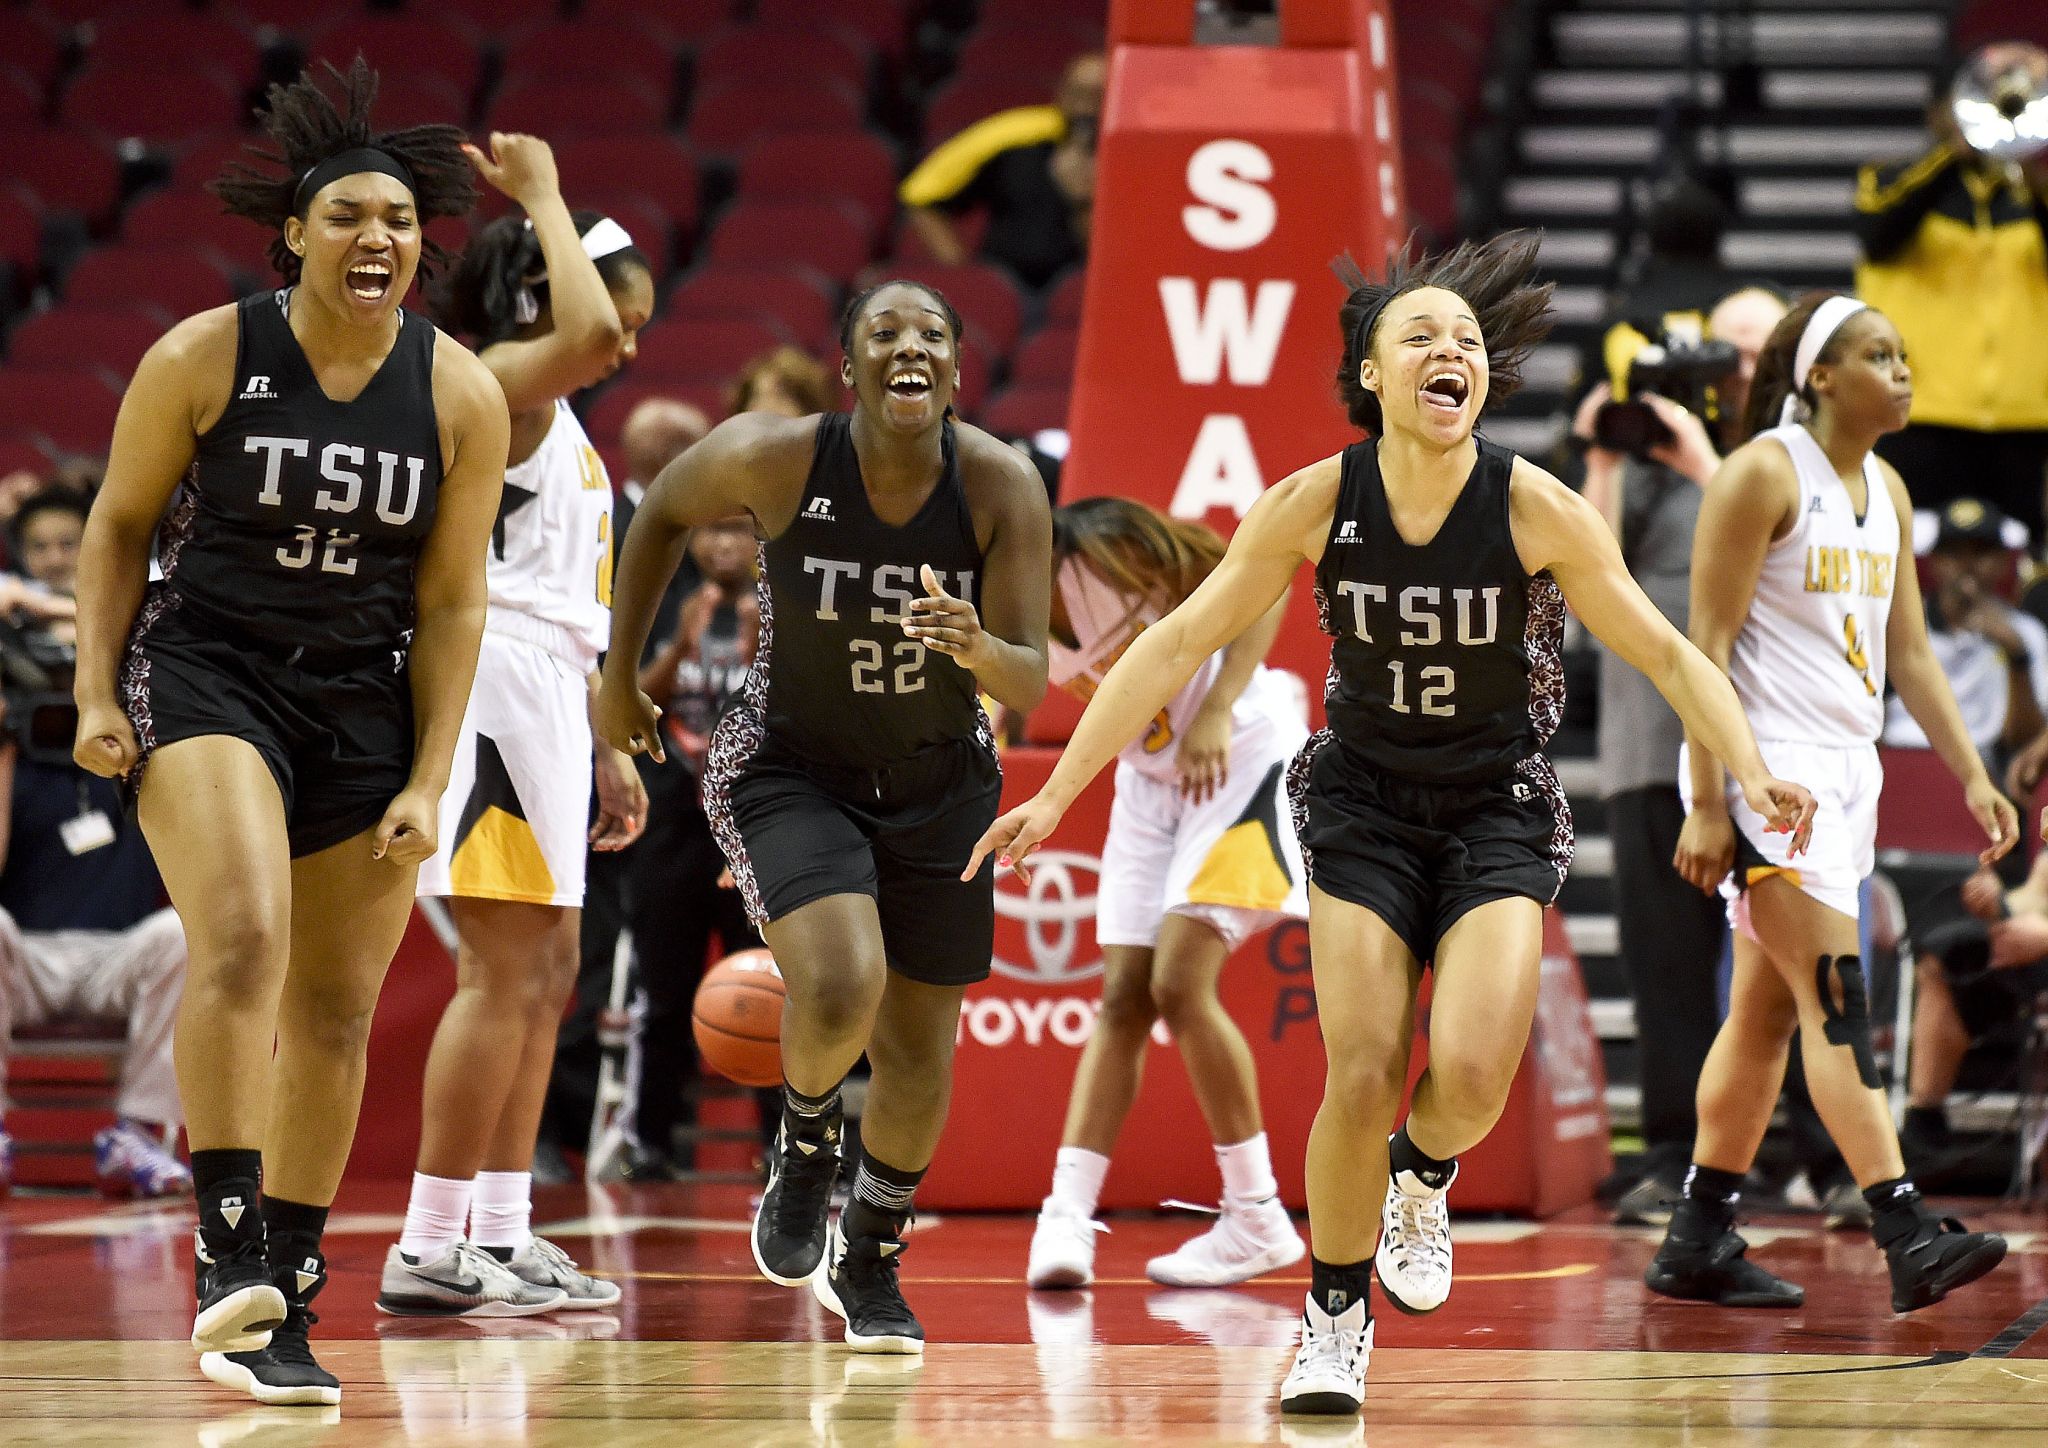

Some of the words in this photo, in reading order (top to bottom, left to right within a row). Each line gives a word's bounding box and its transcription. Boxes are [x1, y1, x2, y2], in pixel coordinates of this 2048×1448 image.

[239, 391, 279, 400] RUSSELL
[243, 436, 425, 526] TSU
[800, 511, 837, 522] RUSSELL
[275, 523, 361, 576] 32
[1336, 580, 1502, 646] TSU
[849, 638, 926, 694] 22
[1387, 659, 1456, 717] 12
